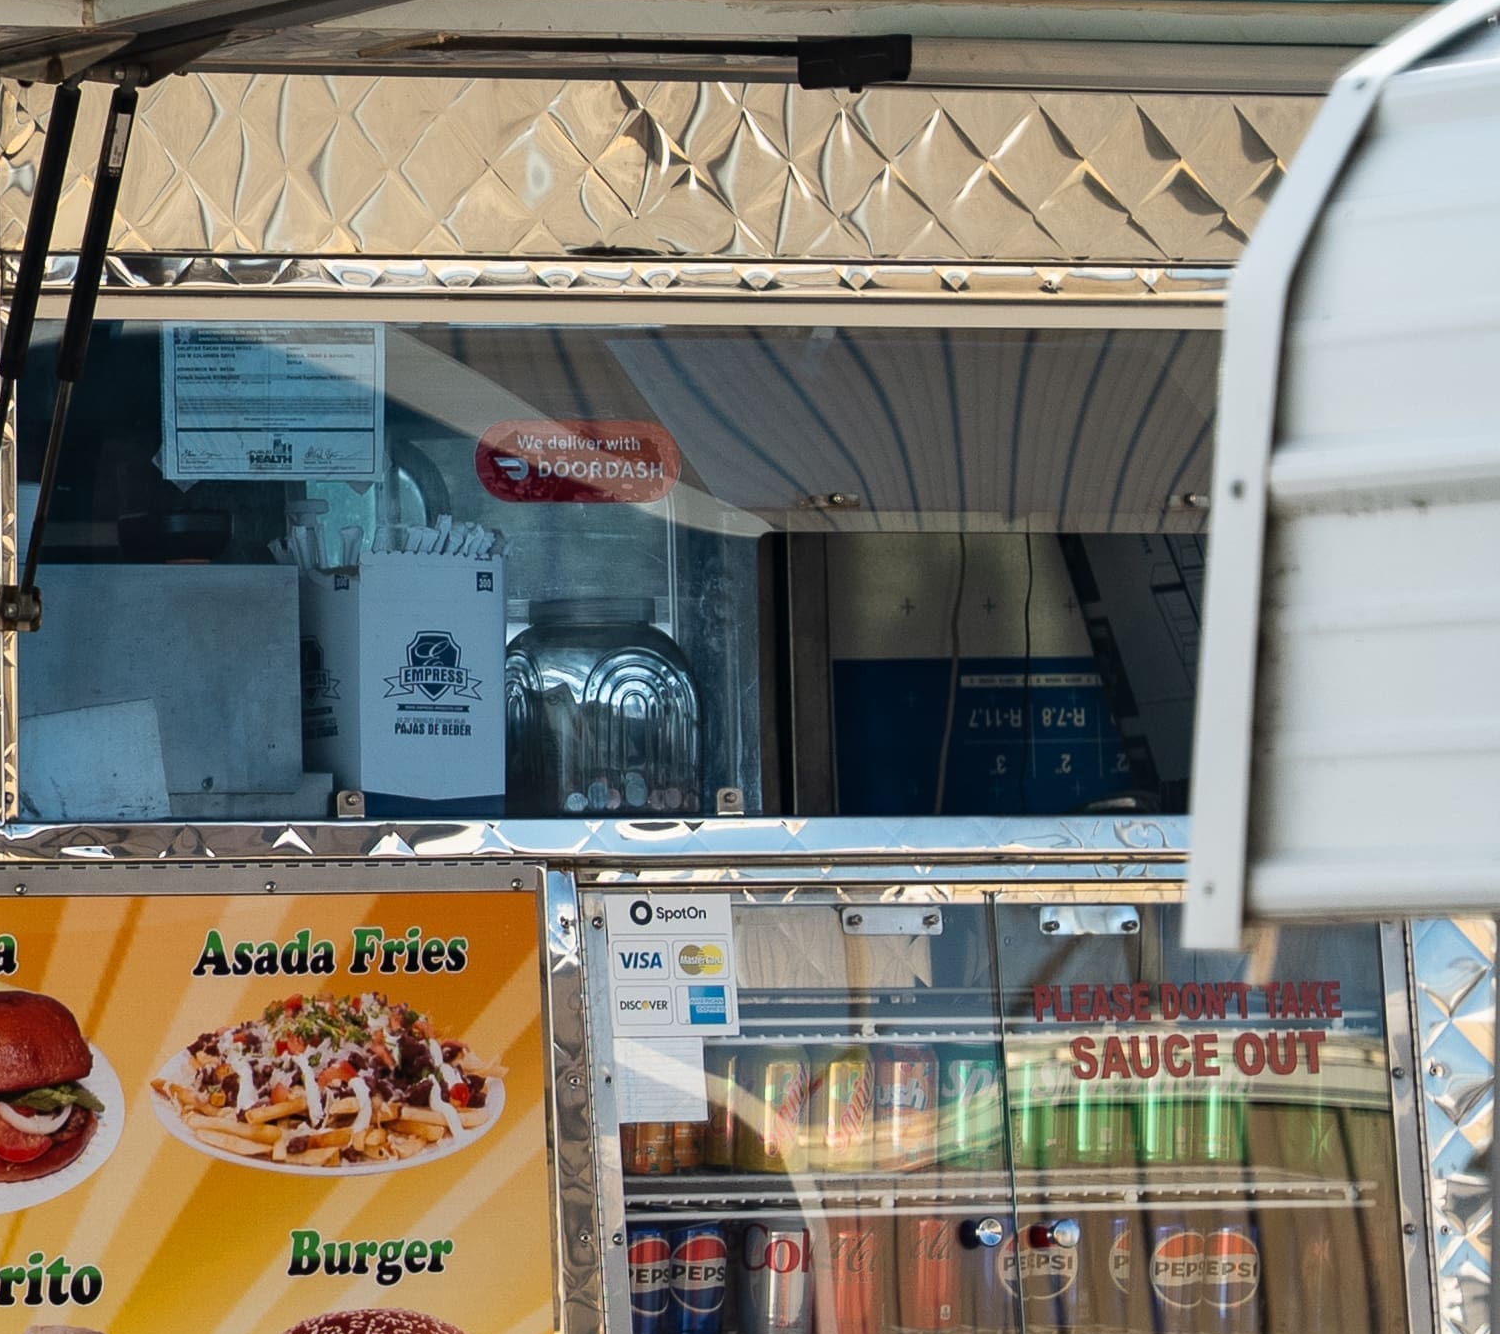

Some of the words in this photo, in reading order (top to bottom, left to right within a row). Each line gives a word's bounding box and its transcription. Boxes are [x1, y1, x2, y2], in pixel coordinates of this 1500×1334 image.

[516, 434, 543, 450] We
[547, 434, 602, 450] deliver
[605, 434, 641, 450] with
[537, 461, 664, 479] DOORDASH
[404, 668, 463, 684] EMPRESS
[1041, 706, 1086, 727] R-7.8
[655, 906, 707, 923] SpotOn
[192, 928, 337, 977] Asada
[347, 926, 469, 975] Fries
[618, 951, 663, 969] VISA
[619, 1000, 669, 1011] DISCOVER
[1033, 982, 1152, 1022] PLEASE
[1159, 981, 1252, 1020] DON'T
[1265, 980, 1343, 1019] TAKE
[1070, 1033, 1221, 1080] SAUCE
[1233, 1031, 1326, 1076] OUT
[286, 1228, 455, 1284] Burger
